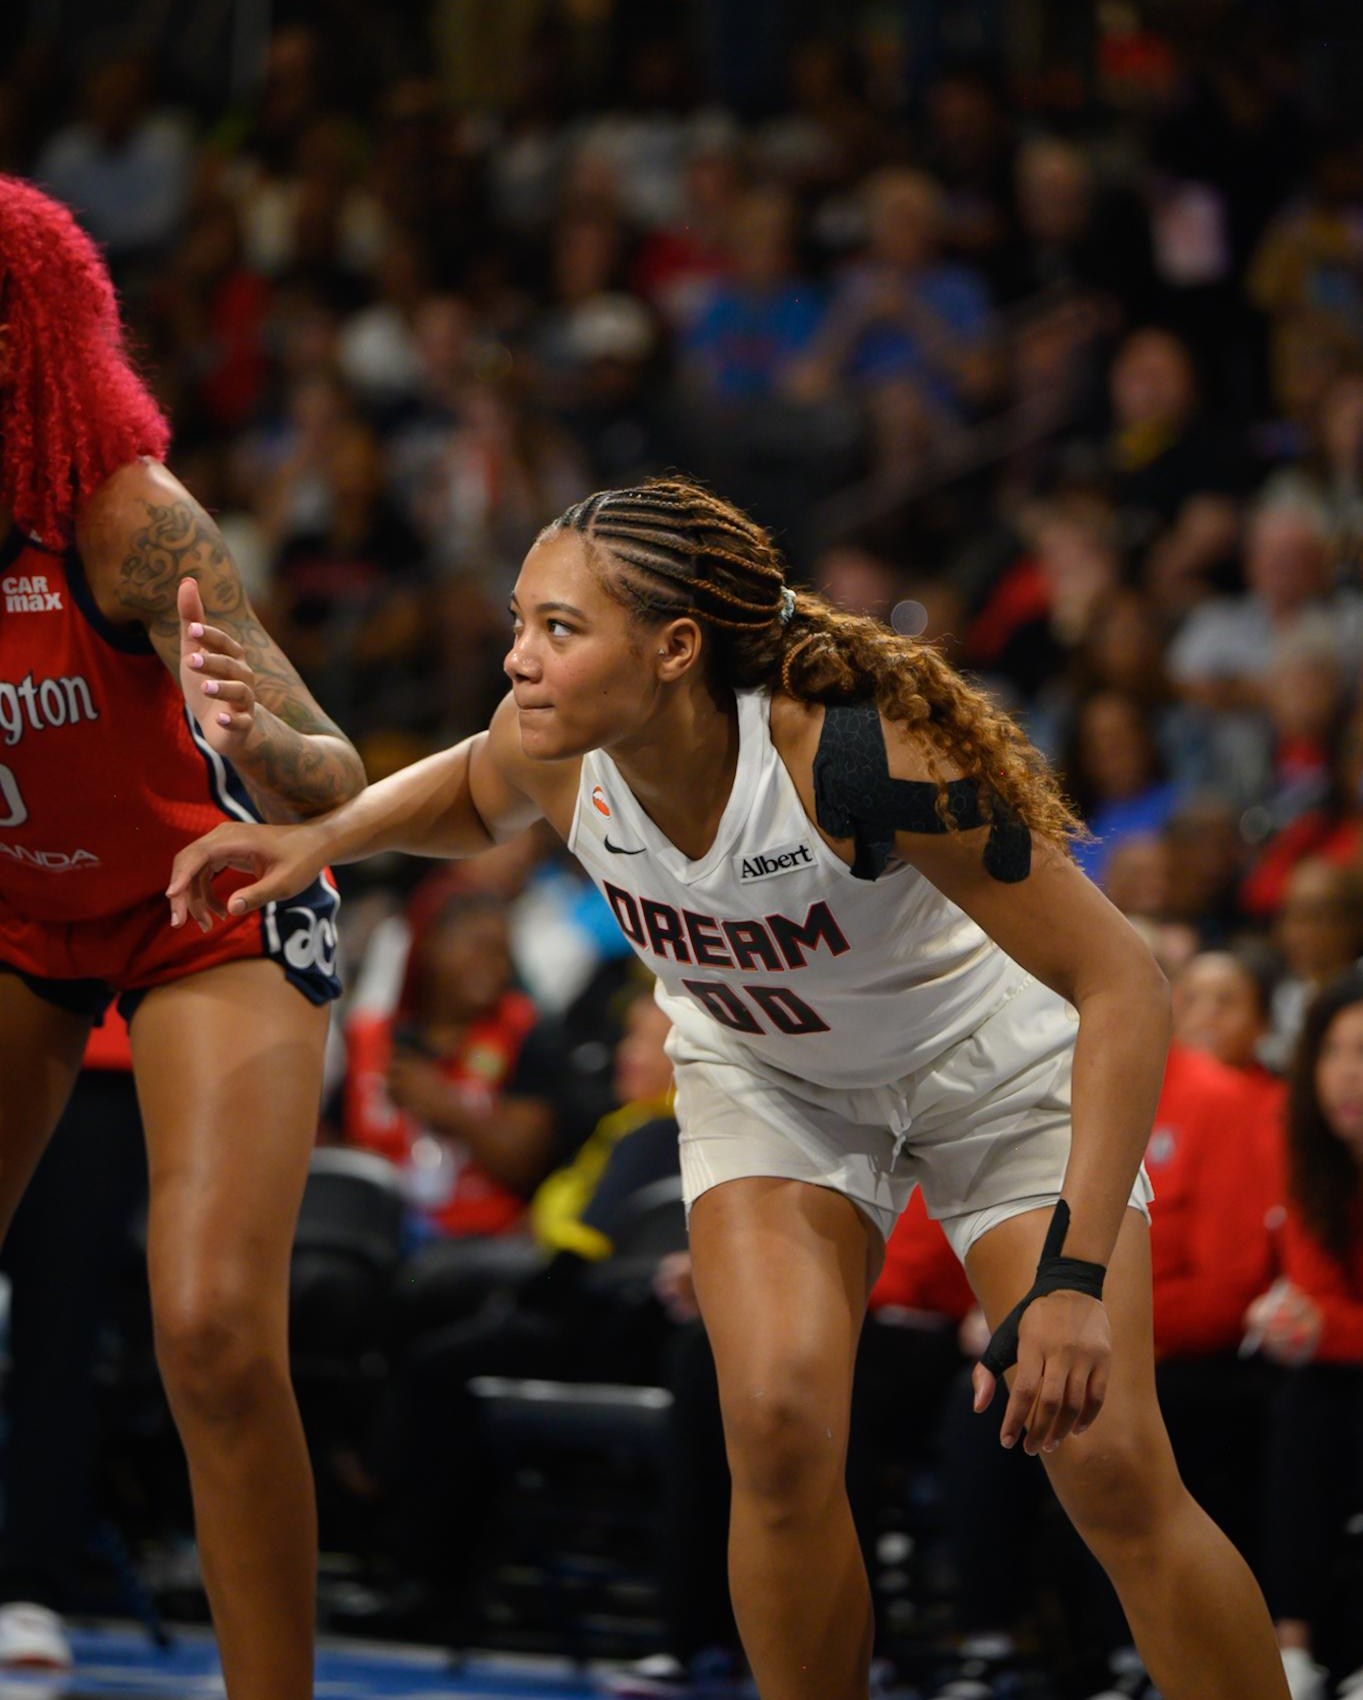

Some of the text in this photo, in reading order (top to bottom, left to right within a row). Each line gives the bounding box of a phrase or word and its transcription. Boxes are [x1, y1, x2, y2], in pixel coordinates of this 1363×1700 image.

[2, 576, 48, 594] CAR
[6, 592, 63, 613] max
[742, 844, 813, 878] Albert
[603, 880, 851, 972] DREAM
[681, 978, 831, 1036] 00
